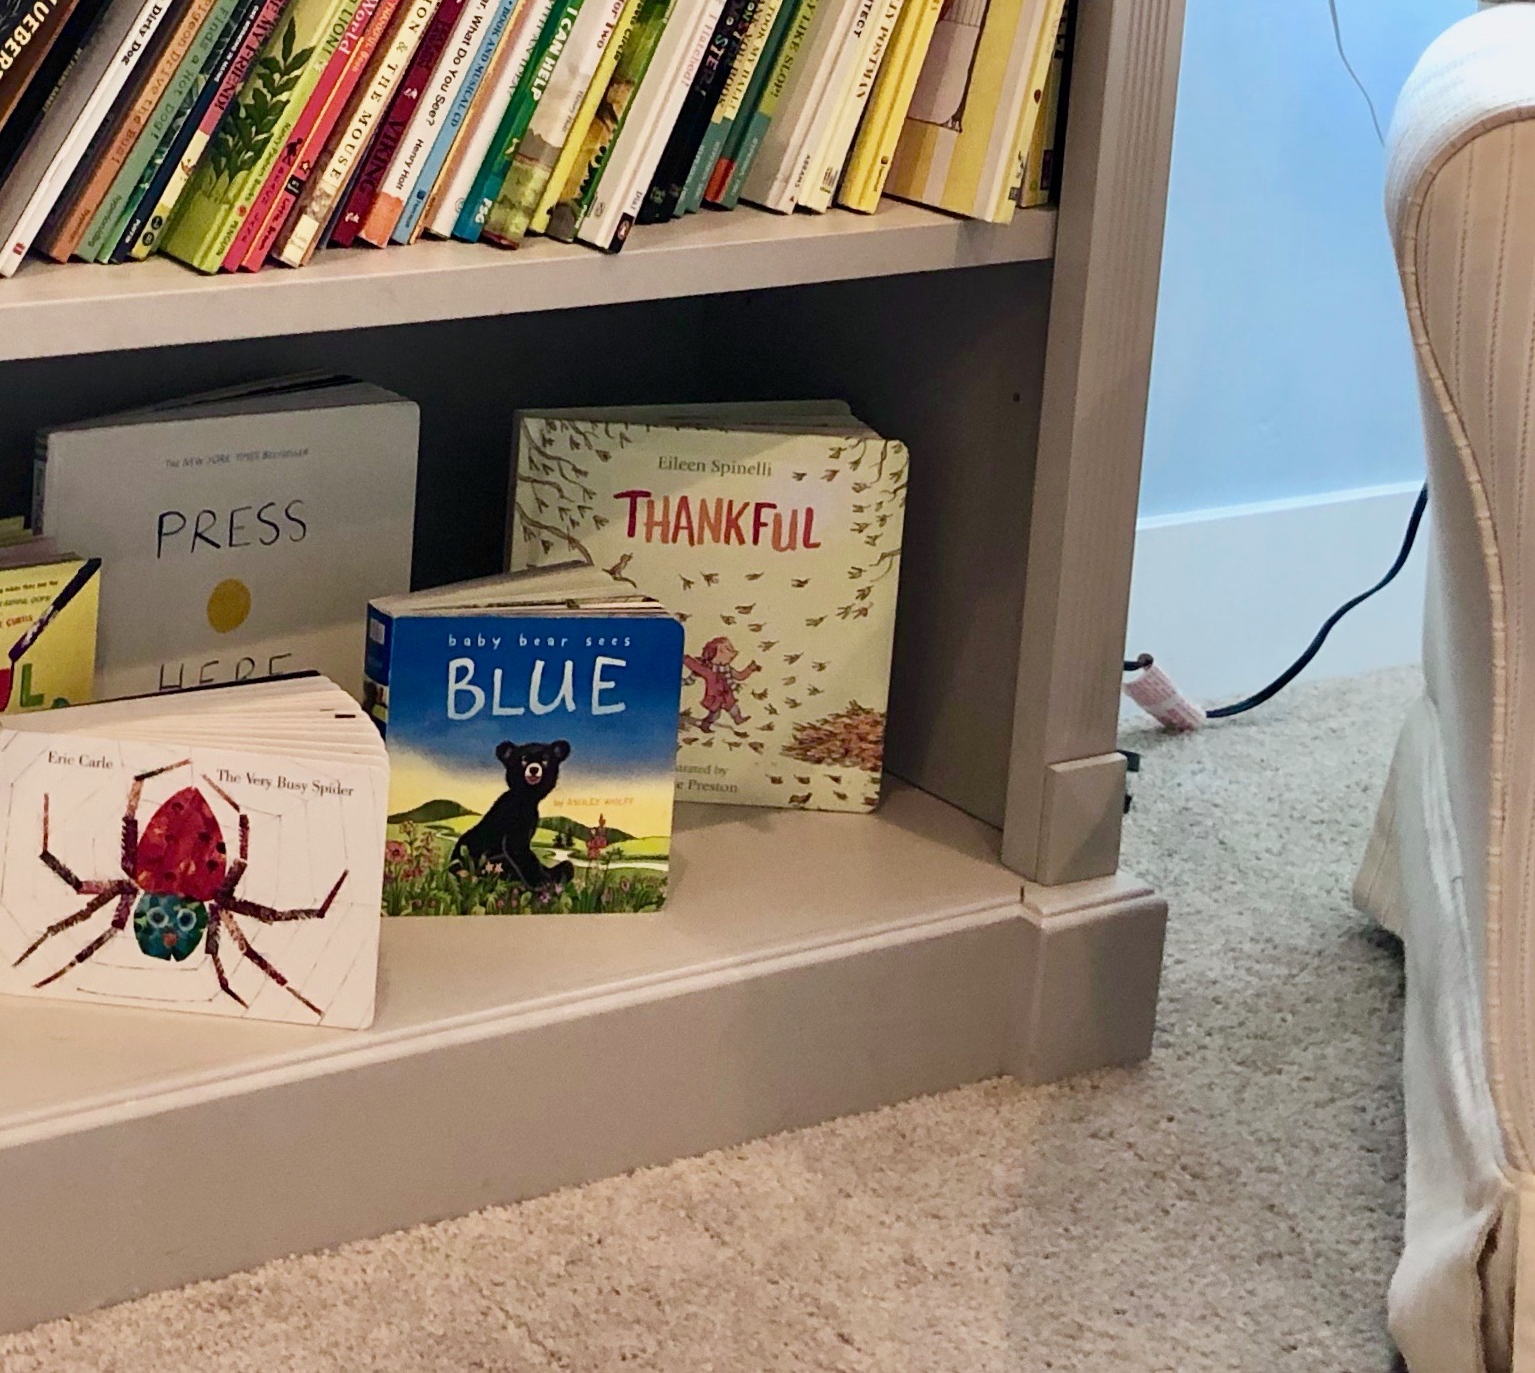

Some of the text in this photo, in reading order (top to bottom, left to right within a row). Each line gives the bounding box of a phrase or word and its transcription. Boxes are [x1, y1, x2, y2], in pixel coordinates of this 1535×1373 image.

[135, 2, 163, 39] Dirty
[248, 14, 273, 44] MY
[321, 7, 353, 55] LION!
[459, 12, 484, 48] What
[594, 20, 615, 51] Two
[788, 13, 811, 52] LIKE
[119, 39, 142, 67] Dog
[395, 40, 410, 55] &
[450, 46, 468, 68] Do
[527, 5, 578, 101] I CAN HELP
[853, 25, 888, 100] POSTMAN
[148, 49, 180, 97] Drive
[213, 43, 256, 112] FRIEND!
[368, 60, 399, 104] THE
[437, 66, 458, 95] You
[768, 53, 793, 98] SLOP!
[131, 97, 154, 125] the
[422, 92, 446, 128] See?
[109, 127, 137, 165] Bus!
[327, 109, 373, 182] MOUSE
[393, 137, 425, 192] Henry Holt
[658, 456, 772, 477] Eileen Spinelli
[157, 499, 307, 559] PRESS
[614, 489, 821, 552] THANKFUL
[449, 633, 631, 649] baby bear sees
[447, 656, 626, 721] BLUE
[48, 750, 113, 770] Eric Carle
[217, 768, 354, 797] The Very Busy Spider
